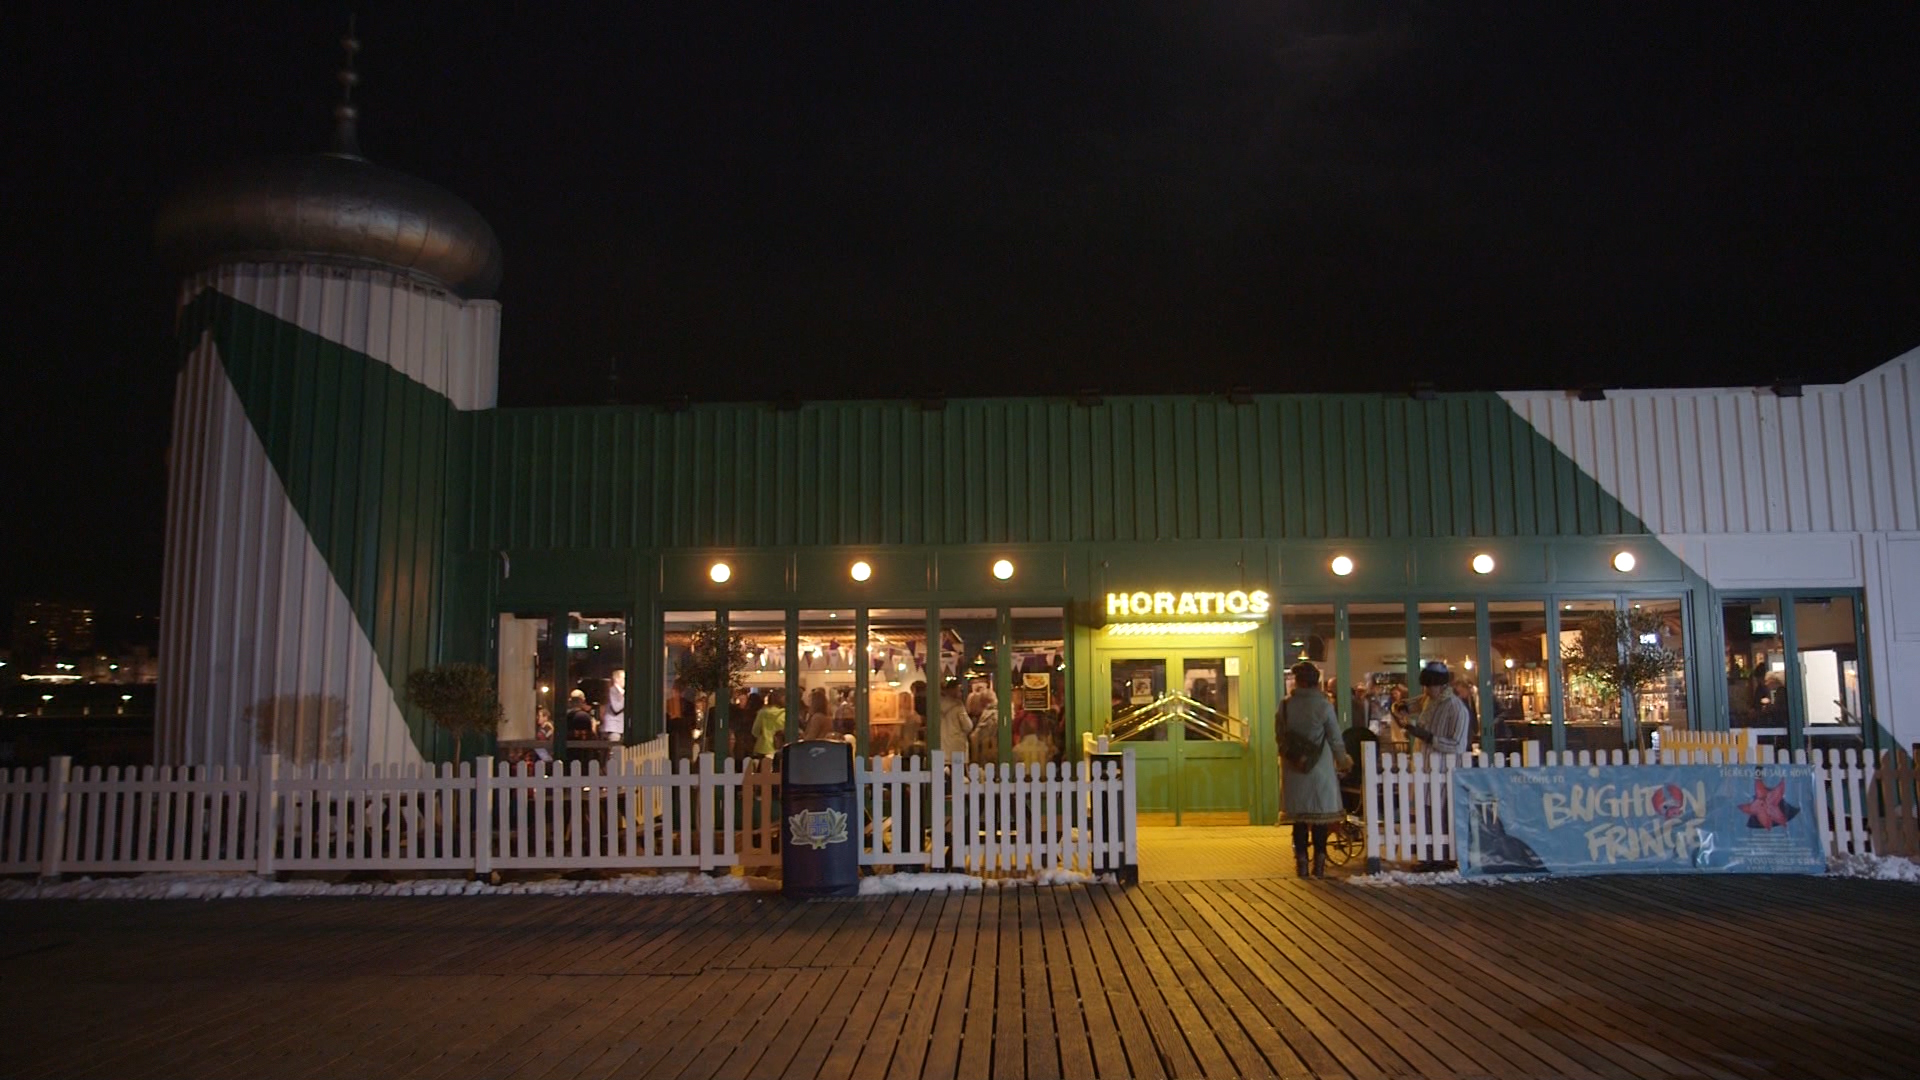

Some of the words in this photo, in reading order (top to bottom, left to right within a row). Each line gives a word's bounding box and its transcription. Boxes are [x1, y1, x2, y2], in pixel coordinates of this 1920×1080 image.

[1106, 590, 1270, 616] HORATIOS
[1543, 770, 1706, 830] BRIGHTON
[1584, 817, 1706, 865] FRINGE
